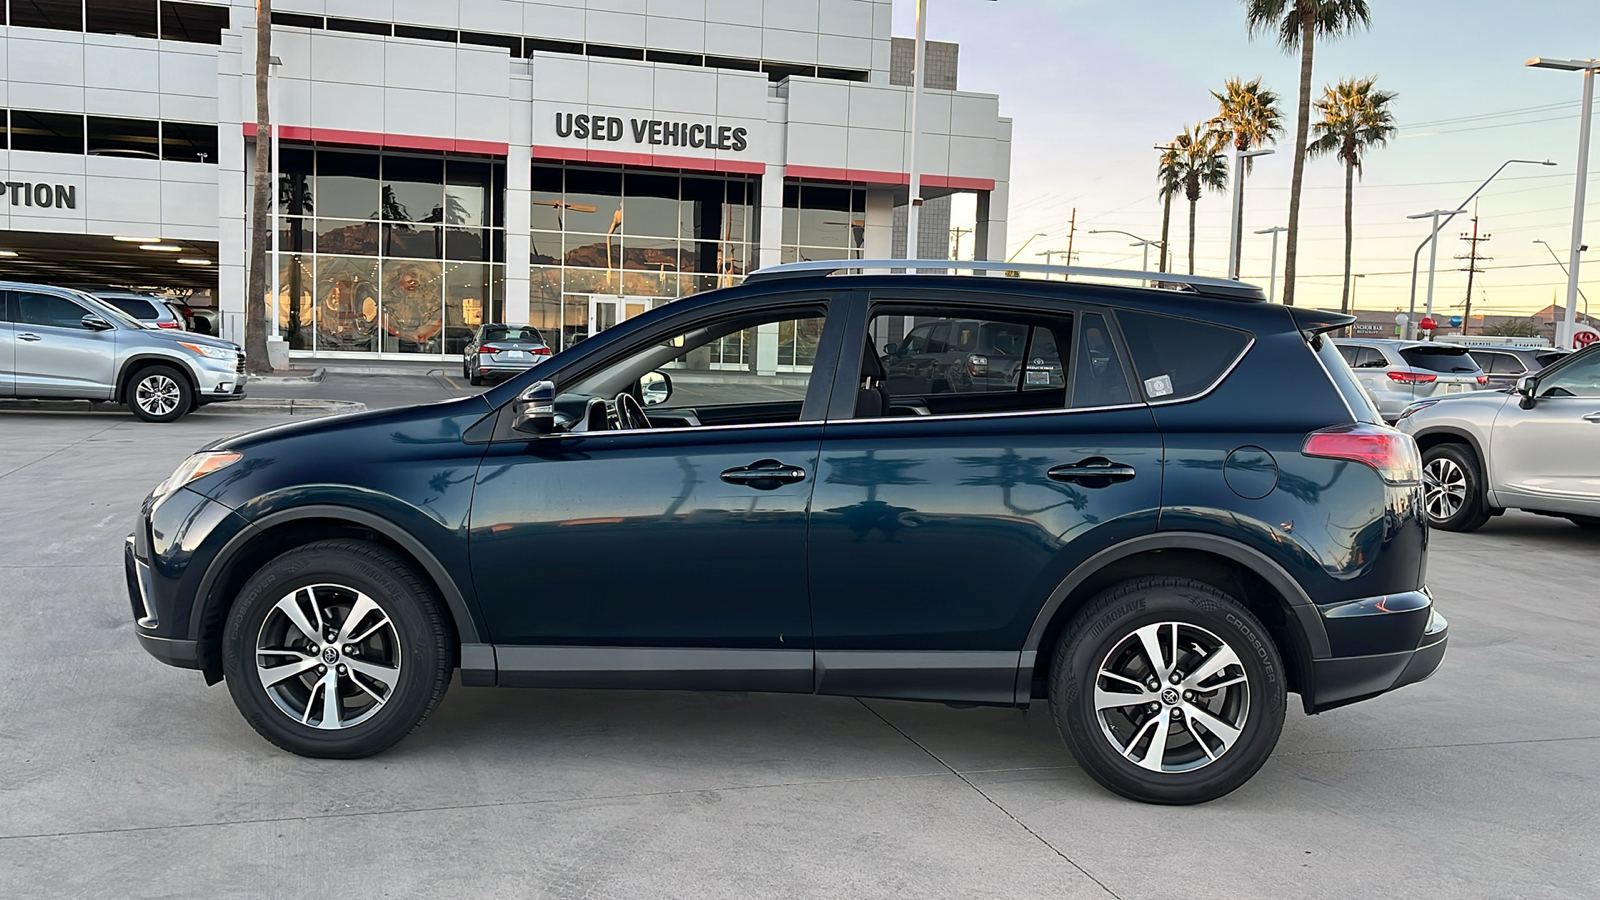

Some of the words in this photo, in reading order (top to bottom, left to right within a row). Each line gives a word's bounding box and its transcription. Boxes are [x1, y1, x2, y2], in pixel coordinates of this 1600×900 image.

[555, 112, 624, 142] USED
[630, 118, 748, 152] VEHICLES
[231, 574, 277, 641] CROSSOVER
[1101, 597, 1147, 631] MOHAVE
[1225, 612, 1277, 684] CROSSOVER
